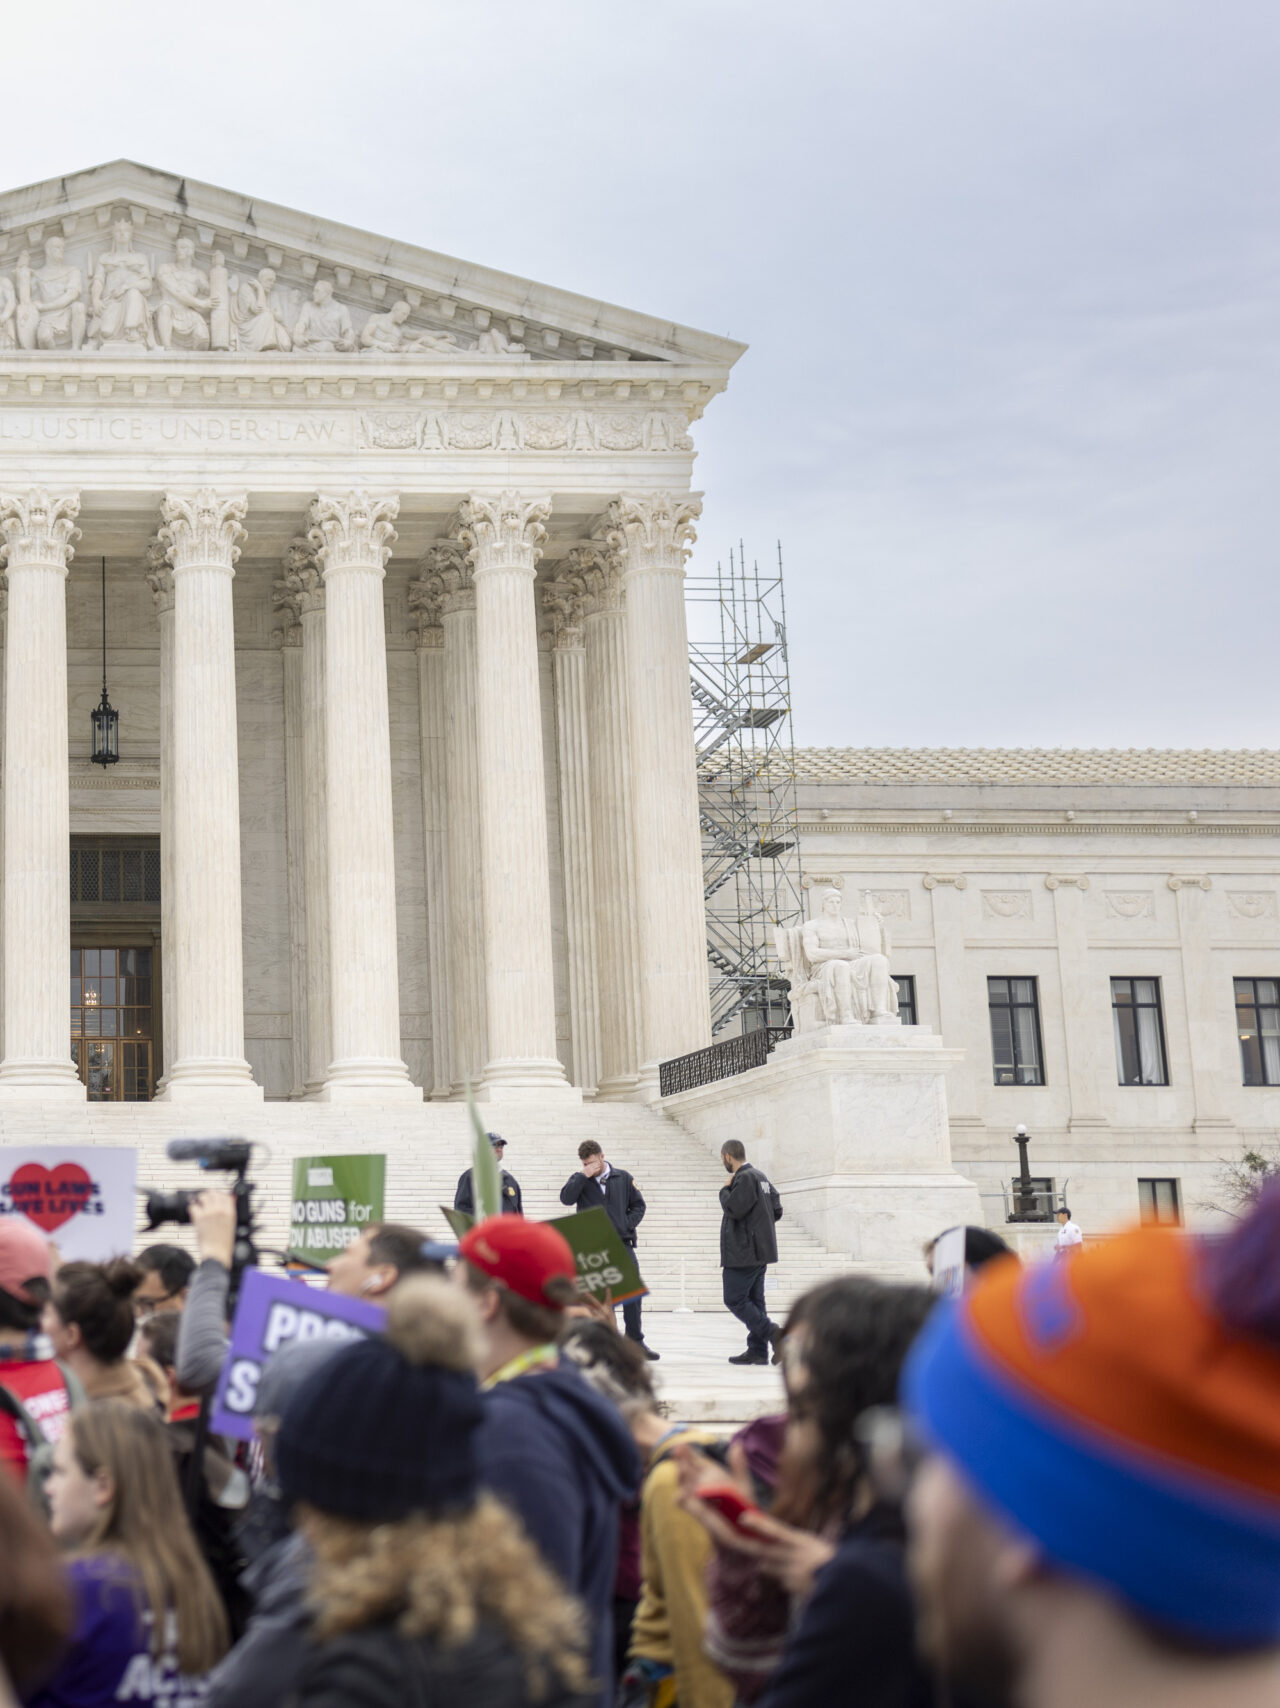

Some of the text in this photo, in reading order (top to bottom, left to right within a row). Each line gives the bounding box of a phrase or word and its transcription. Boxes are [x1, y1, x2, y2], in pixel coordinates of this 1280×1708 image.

[20, 417, 143, 440] JUSTICE
[160, 419, 270, 441] UNDER
[277, 420, 336, 441] LAW
[0, 1181, 101, 1196] GUN LAWS
[49, 1199, 104, 1215] LIVES
[306, 1200, 346, 1223] GUNS
[349, 1201, 373, 1222] for
[577, 1250, 610, 1270] for
